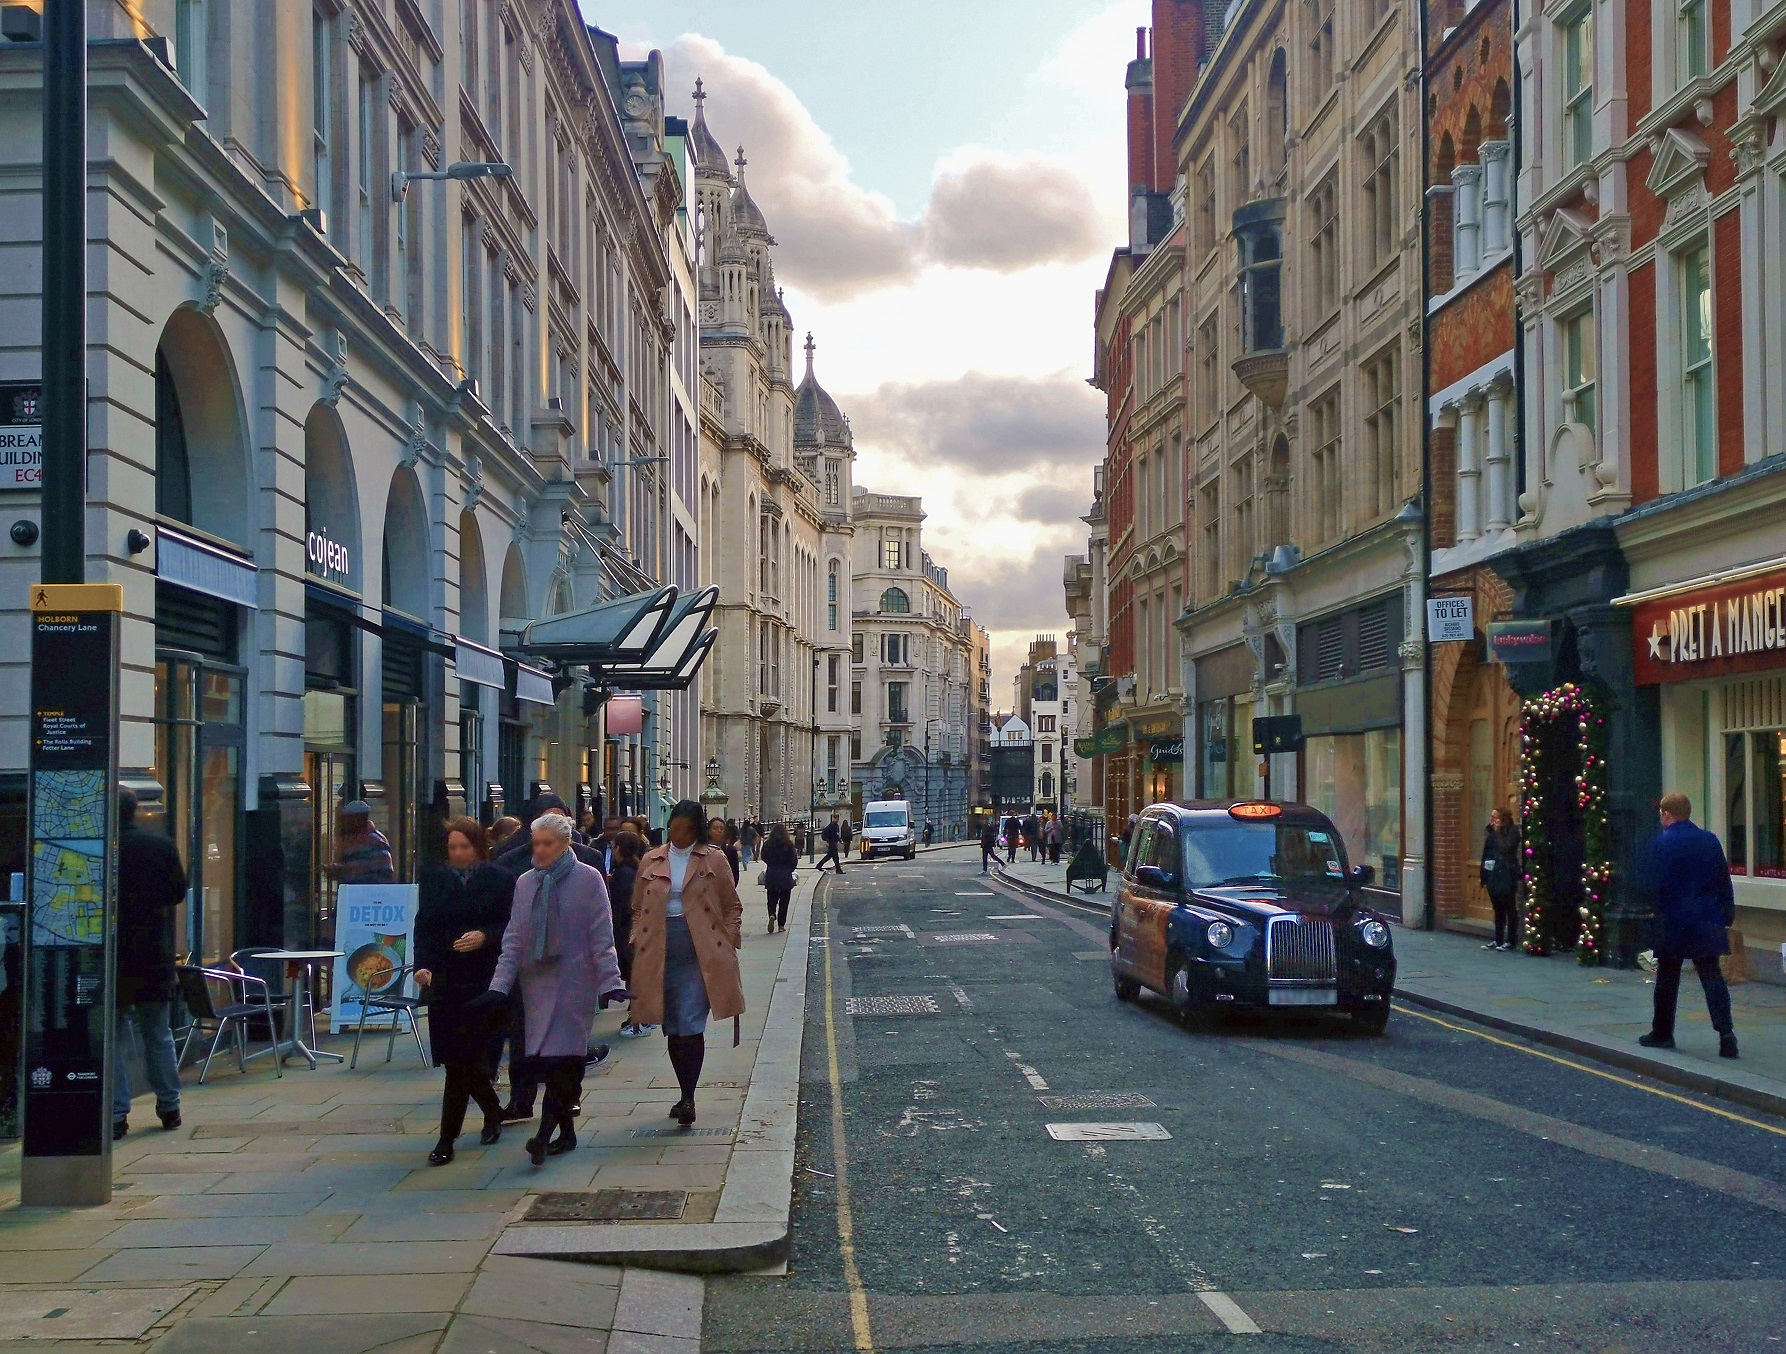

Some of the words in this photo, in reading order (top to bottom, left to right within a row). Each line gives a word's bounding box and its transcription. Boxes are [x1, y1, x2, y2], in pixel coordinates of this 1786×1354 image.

[0, 451, 42, 465] UILDI
[15, 468, 43, 482] EC4
[309, 526, 349, 577] cojean
[1436, 600, 1465, 608] OFFICES
[38, 615, 78, 623] HOLBORN
[1434, 608, 1448, 619] TO
[1451, 607, 1468, 618] LET
[38, 624, 76, 633] Chancery
[1670, 604, 1707, 663] PRET
[1711, 602, 1723, 657] A
[1242, 805, 1272, 815] TAXI
[350, 905, 405, 922] DETOX
